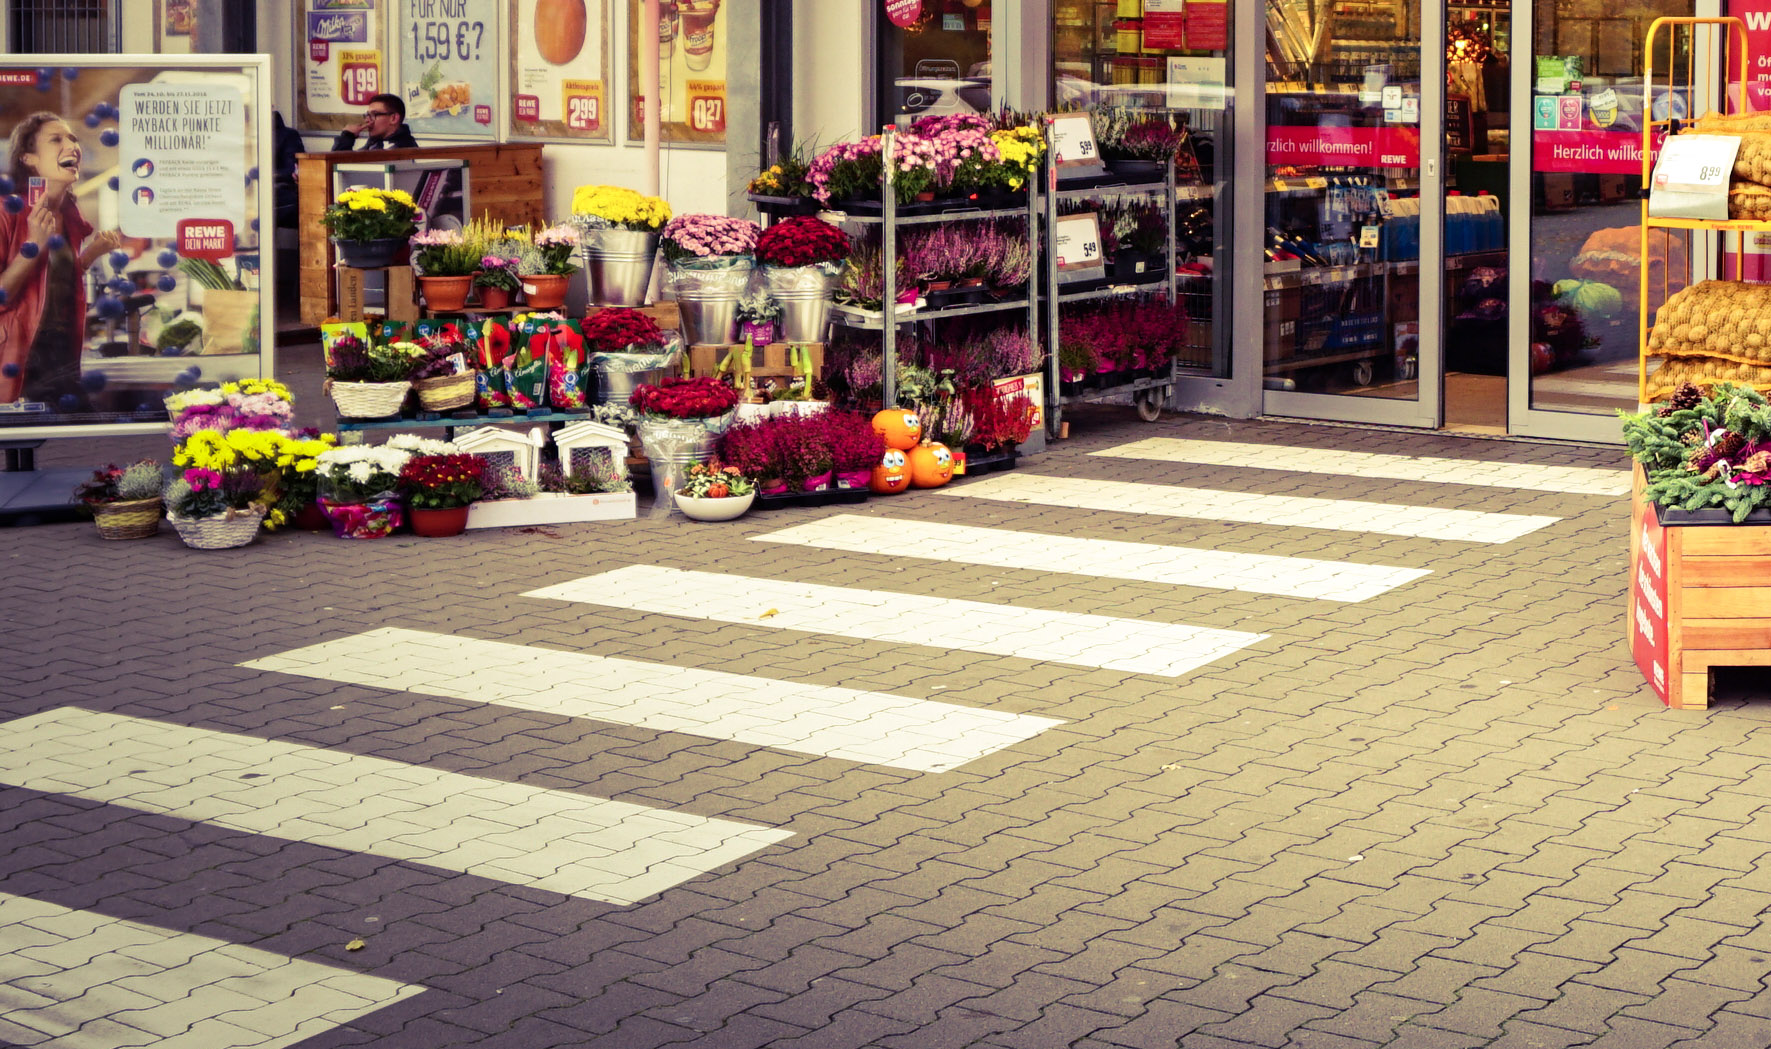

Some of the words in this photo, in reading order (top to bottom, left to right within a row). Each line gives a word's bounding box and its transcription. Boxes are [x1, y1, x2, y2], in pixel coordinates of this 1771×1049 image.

[316, 14, 345, 39] Milka
[411, 20, 450, 64] 1,59
[455, 21, 485, 61] €?
[342, 67, 377, 102] 1.99
[565, 81, 600, 92] Aktionspreis
[134, 100, 179, 115] WERDEN
[183, 100, 201, 115] SIE
[204, 100, 232, 116] JETZT
[518, 99, 536, 108] REWE
[569, 97, 597, 128] 2.99
[693, 99, 722, 130] 0.27
[132, 117, 178, 133] PAYBACK
[182, 117, 221, 132] PUNKTE
[1079, 140, 1093, 155] 5.99
[1267, 137, 1295, 153] rzlich
[1298, 139, 1373, 155] willkommen!
[1553, 143, 1604, 160] Herzlich
[1607, 145, 1660, 162] willkom
[1380, 154, 1407, 165] REWE
[1699, 165, 1722, 182] 8.99
[185, 226, 225, 238] REWE
[185, 238, 201, 250] DEIN
[202, 238, 225, 250] MARKT
[1083, 241, 1097, 258] 5.49
